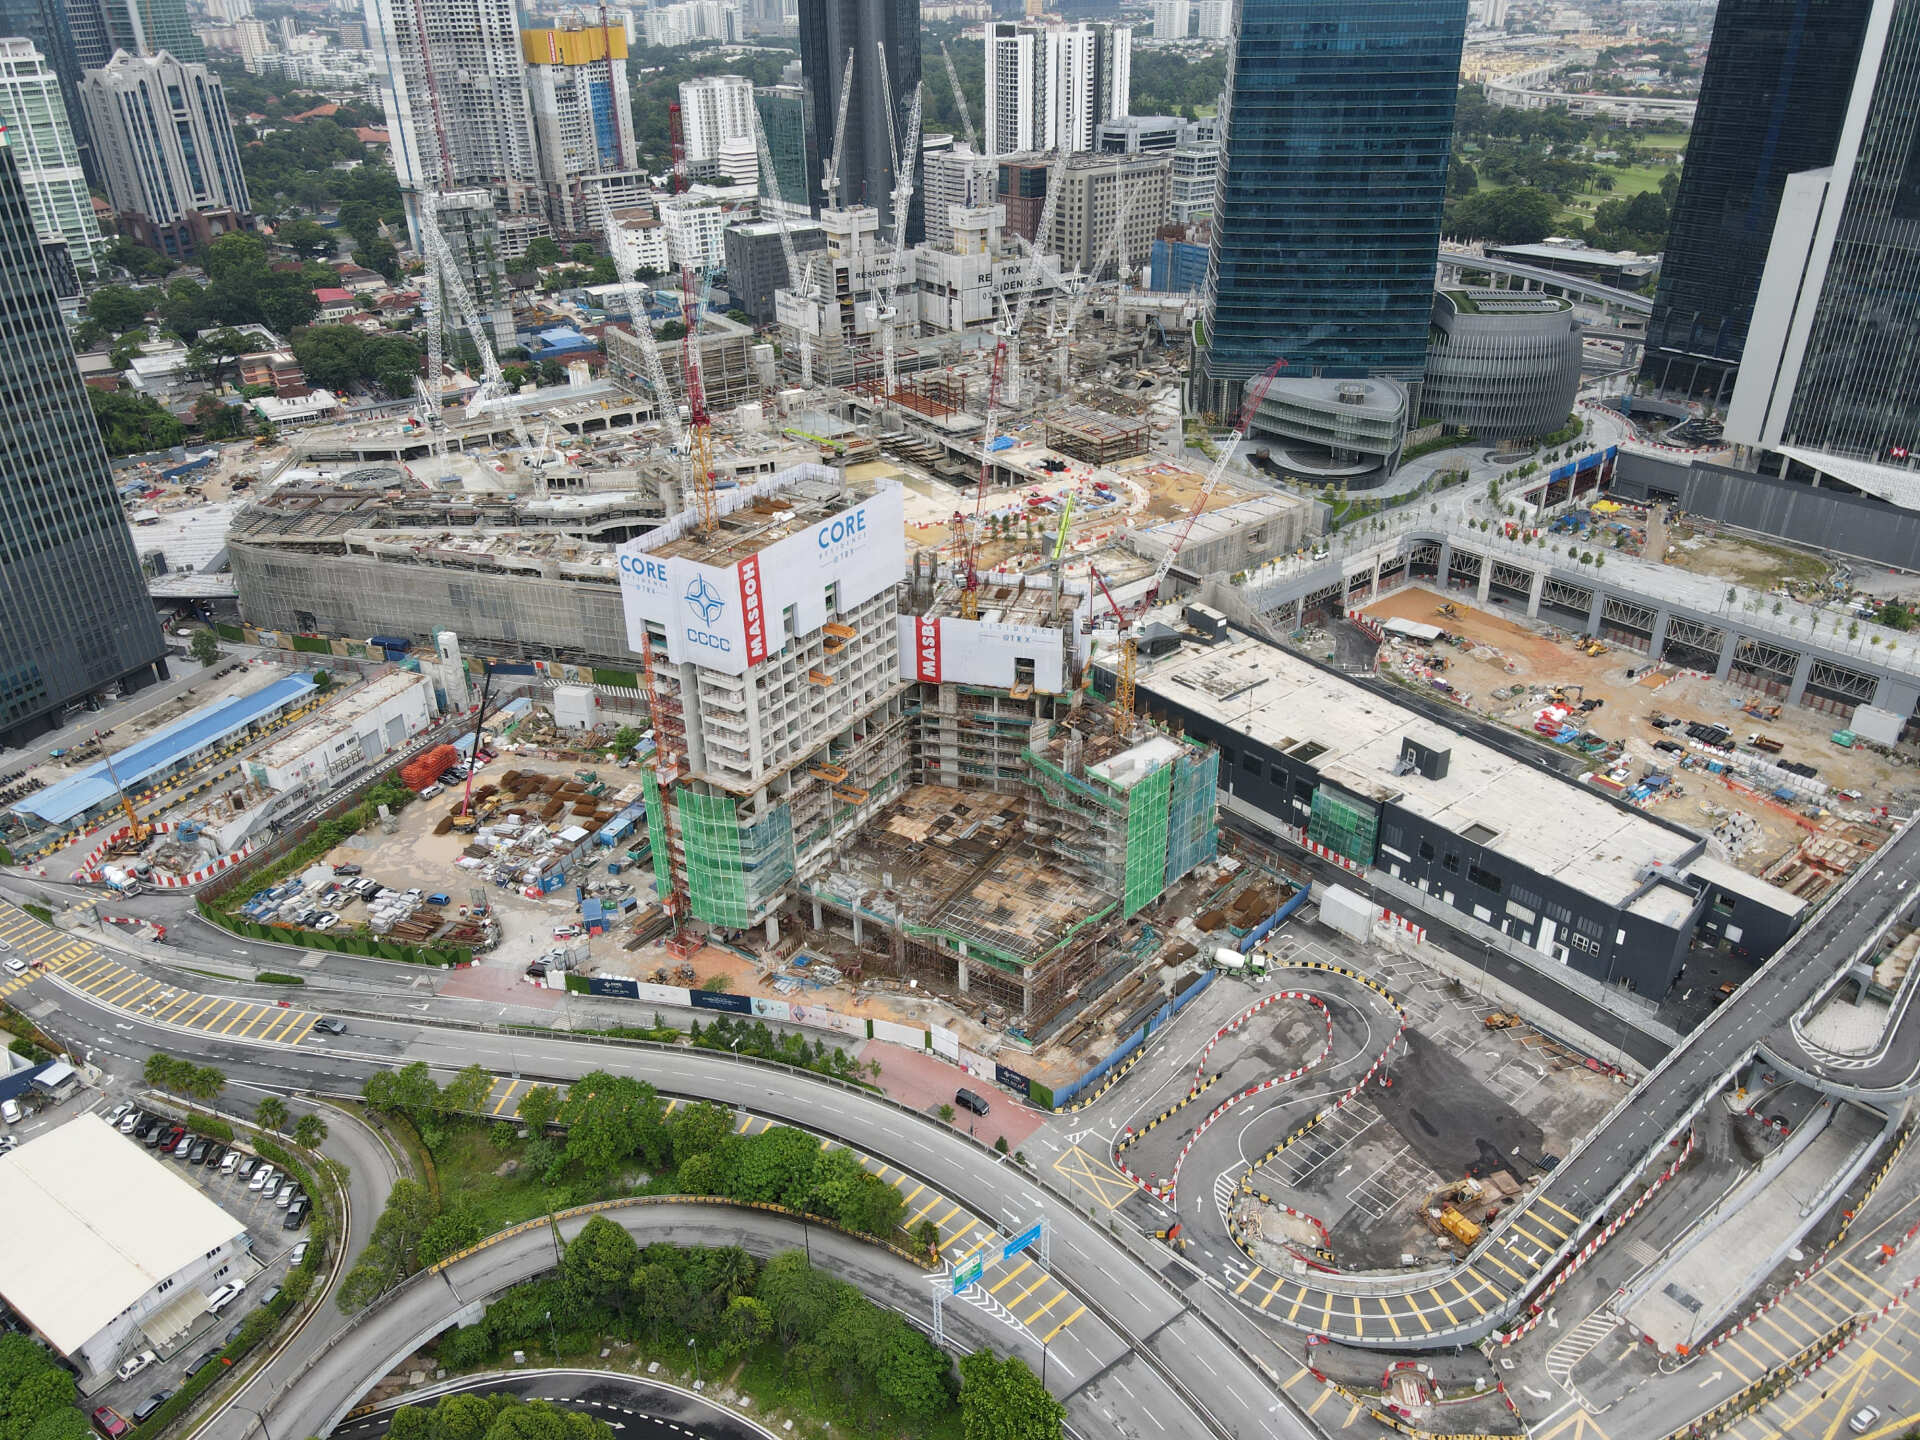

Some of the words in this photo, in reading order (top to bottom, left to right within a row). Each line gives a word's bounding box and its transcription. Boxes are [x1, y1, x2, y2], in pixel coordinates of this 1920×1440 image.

[876, 258, 890, 266] TRX
[1001, 265, 1021, 276] TRX
[818, 509, 866, 549] CORE
[620, 554, 667, 581] CORE
[742, 560, 763, 657] MASBOH
[688, 628, 731, 652] CCCC
